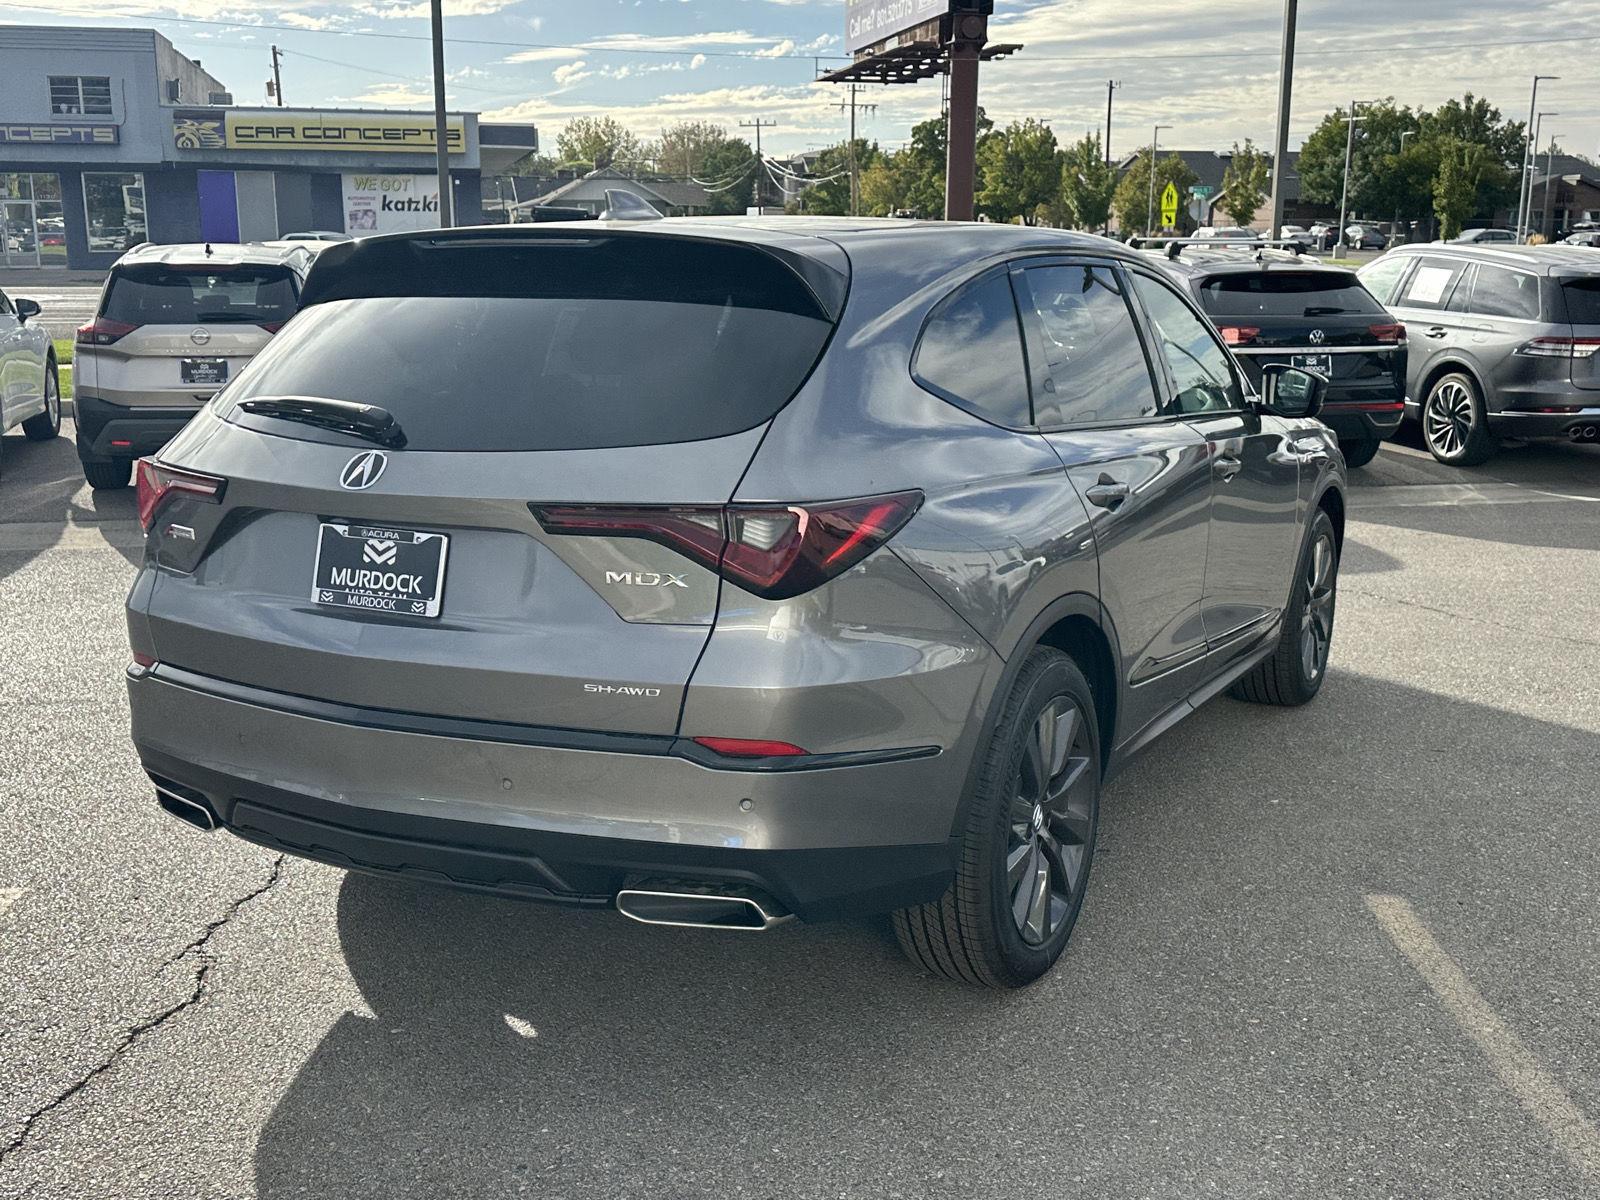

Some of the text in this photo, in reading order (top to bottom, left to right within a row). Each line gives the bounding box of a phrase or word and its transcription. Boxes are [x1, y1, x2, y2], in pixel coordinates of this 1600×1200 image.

[850, 16, 861, 39] Call
[234, 126, 461, 141] CAR CONCEPTS
[354, 176, 412, 192] WE GOT
[367, 530, 400, 540] ACURA
[331, 567, 422, 594] MURDOCK
[605, 571, 689, 588] MDX
[347, 594, 397, 610] MURDOCK
[583, 683, 661, 697] SH-AWD
